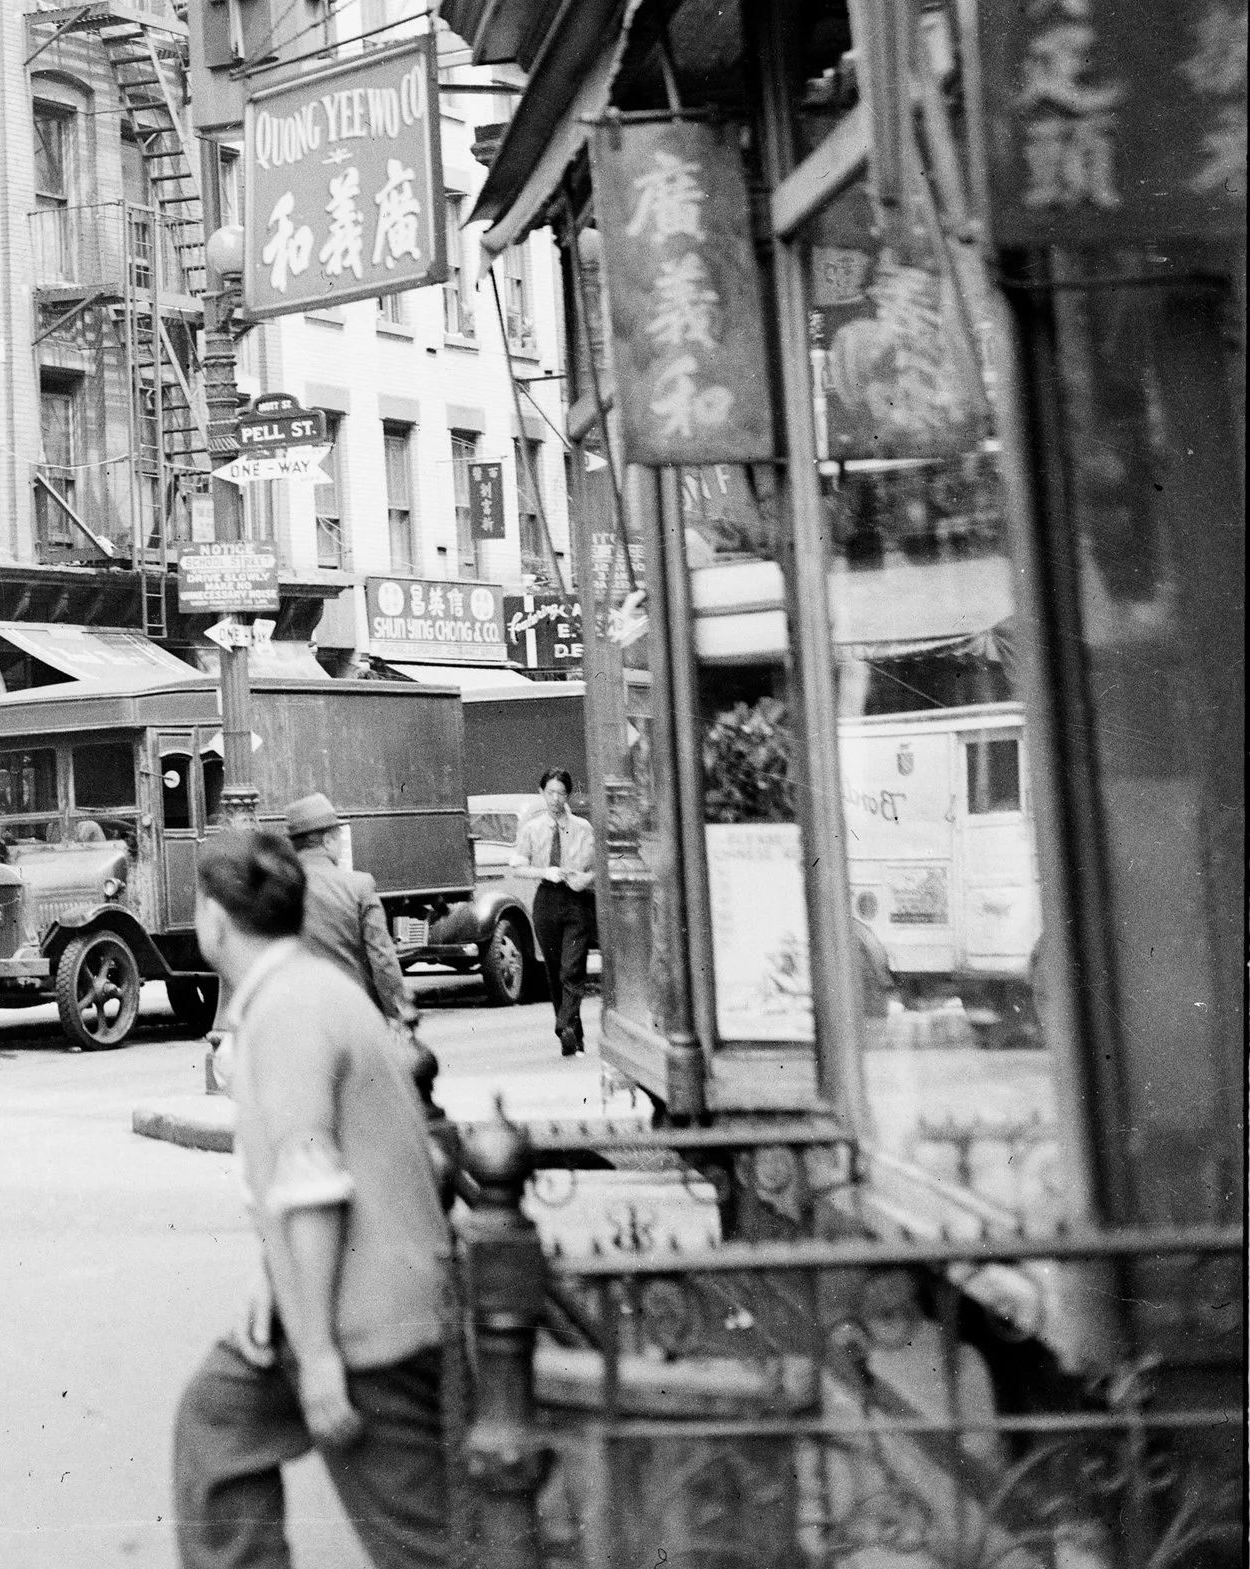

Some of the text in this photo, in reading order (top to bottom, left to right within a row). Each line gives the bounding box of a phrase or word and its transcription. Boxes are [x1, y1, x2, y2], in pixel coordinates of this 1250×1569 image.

[256, 65, 425, 170] QUONG YEE WO CO
[241, 420, 317, 443] PELL ST.
[200, 543, 255, 556] NOTICE
[186, 555, 272, 568] SCHOOL STREET
[186, 572, 271, 583] DRIVE SLOWLY
[236, 581, 252, 590] NO
[373, 616, 406, 639] SHUN
[406, 618, 434, 640] YING
[434, 619, 472, 642] CHONG
